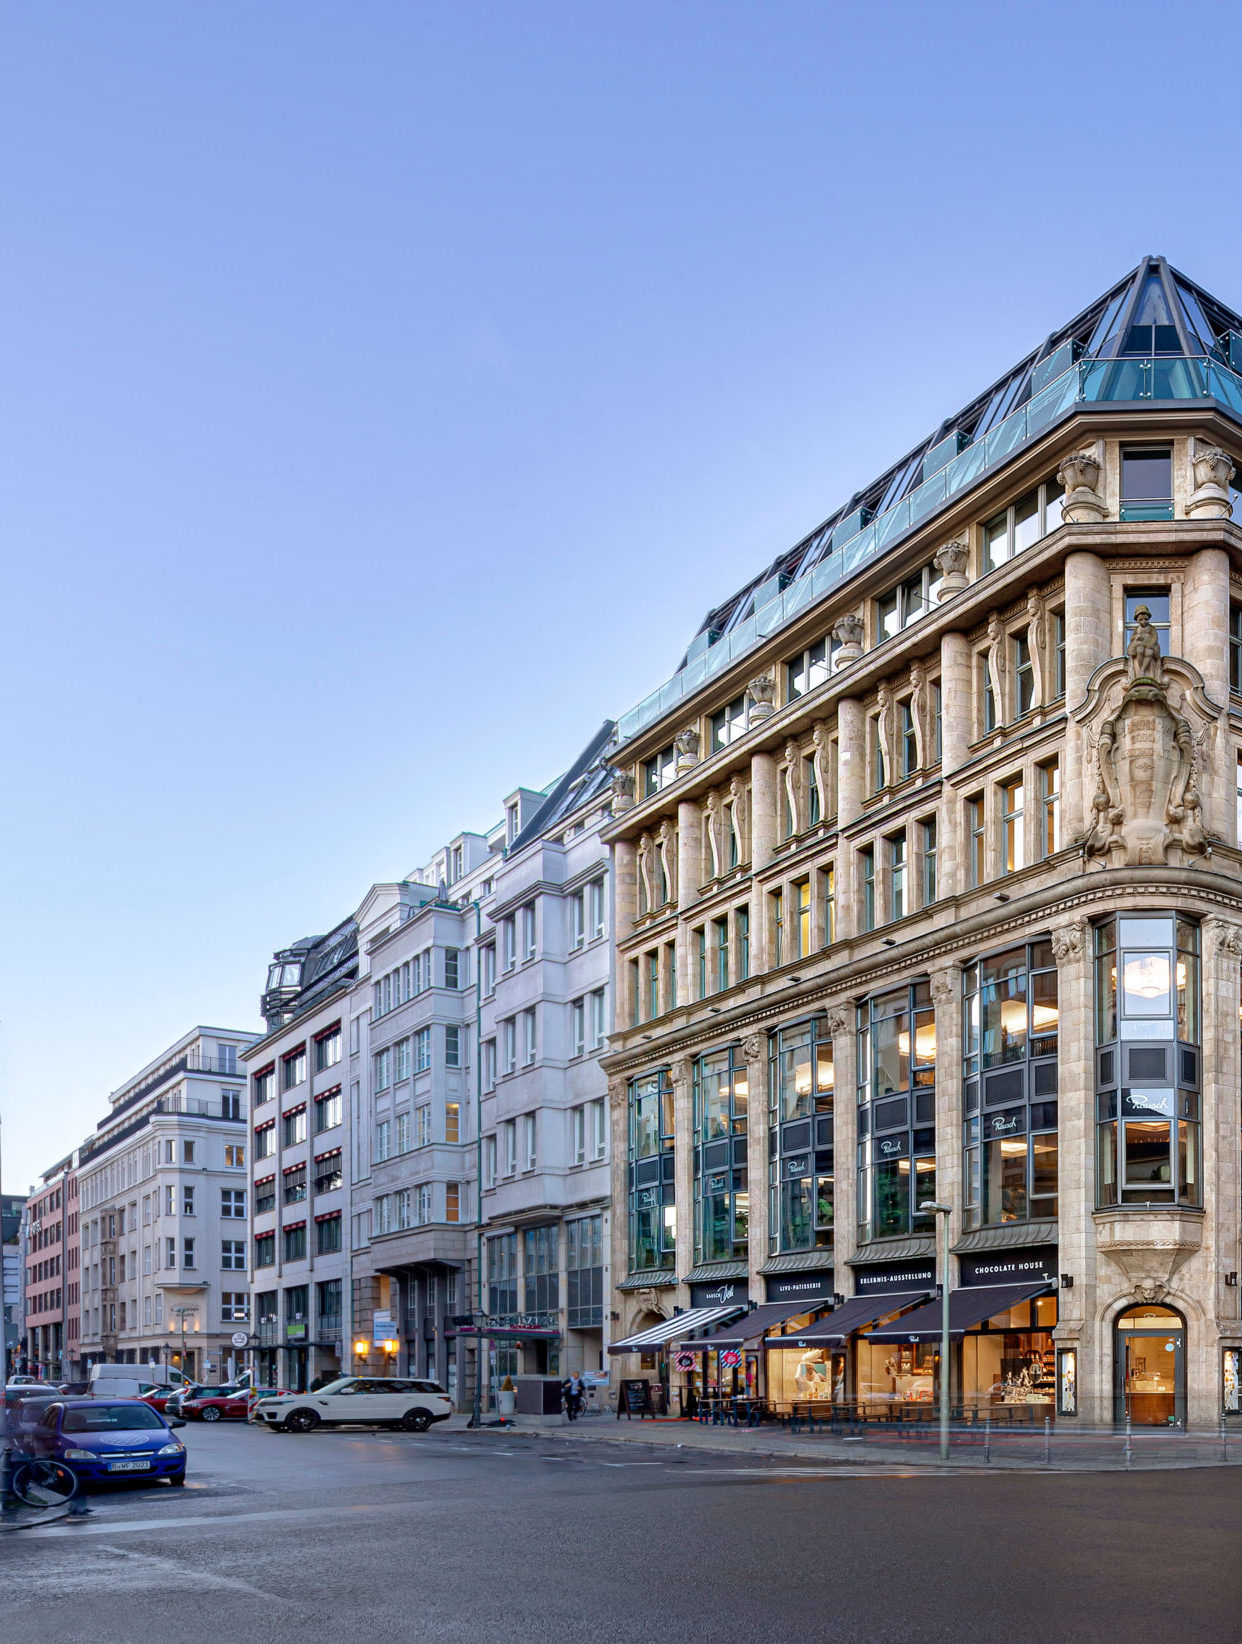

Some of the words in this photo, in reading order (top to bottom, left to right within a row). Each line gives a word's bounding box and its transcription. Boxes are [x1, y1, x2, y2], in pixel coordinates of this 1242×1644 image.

[1126, 1094, 1169, 1110] Rausch
[992, 1116, 1017, 1131] Rausch
[881, 1140, 902, 1154] Rausch
[975, 1263, 1016, 1274] CHOCOLATE
[1018, 1261, 1044, 1270] HOUSE
[860, 1272, 932, 1285] ERLEBNIS-AUSSTELLUNG
